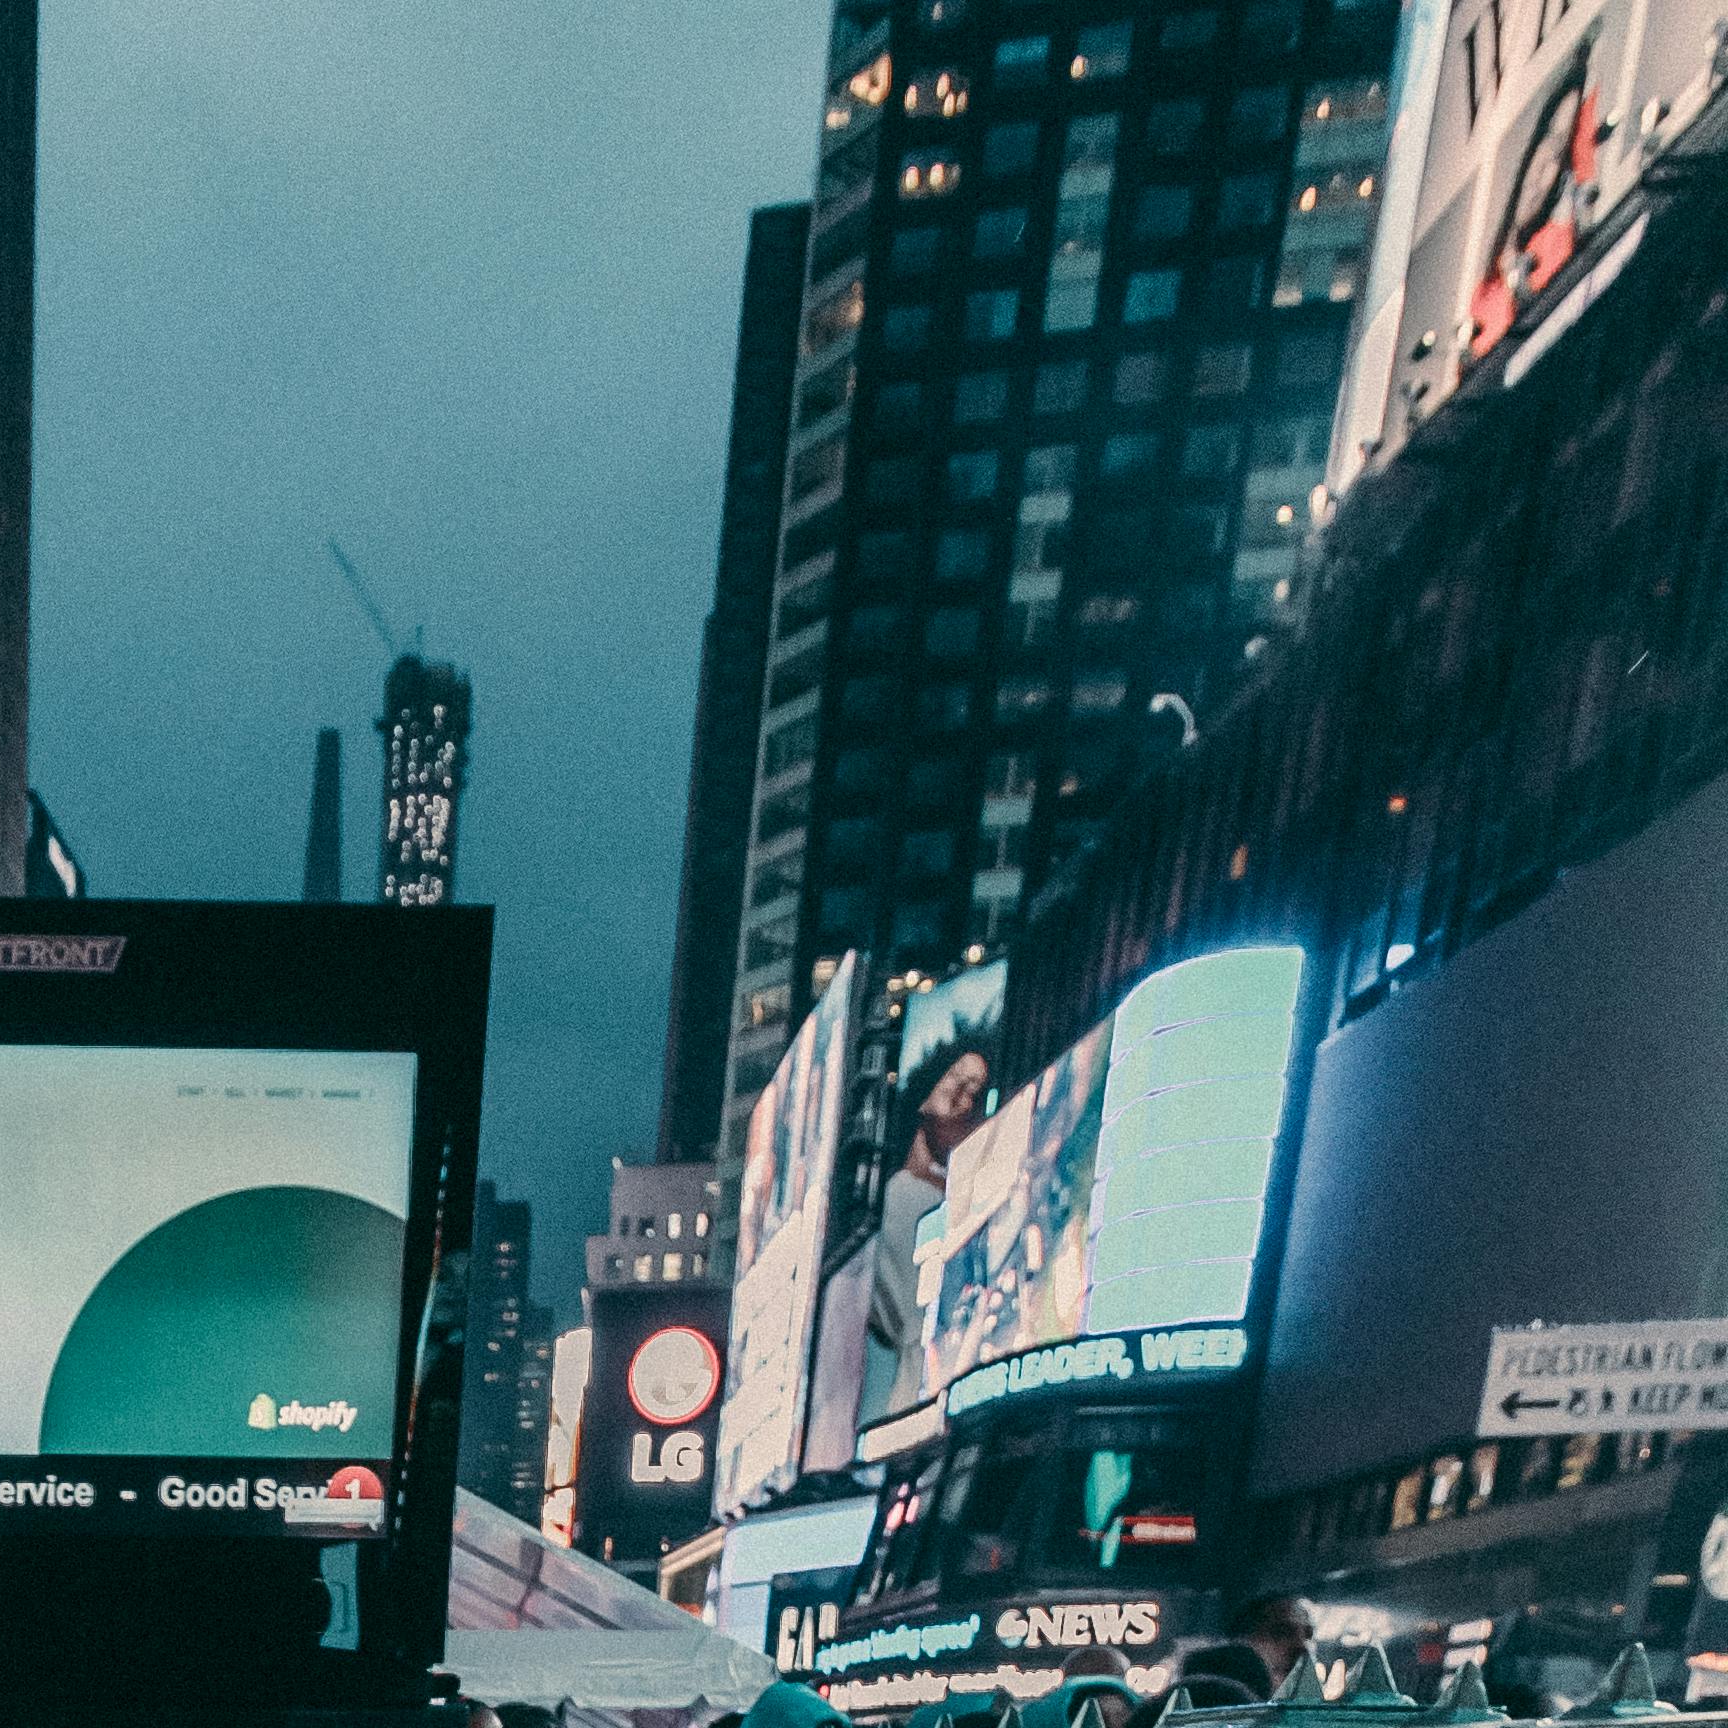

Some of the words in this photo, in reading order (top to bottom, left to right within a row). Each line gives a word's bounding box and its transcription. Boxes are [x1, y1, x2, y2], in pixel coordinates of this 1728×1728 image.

[1502, 1340, 1656, 1379] PEDESTRIAN
[276, 1400, 359, 1433] shopify
[631, 1431, 705, 1483] LG
[159, 1475, 248, 1508] Good
[1024, 1601, 1159, 1648] NEWS
